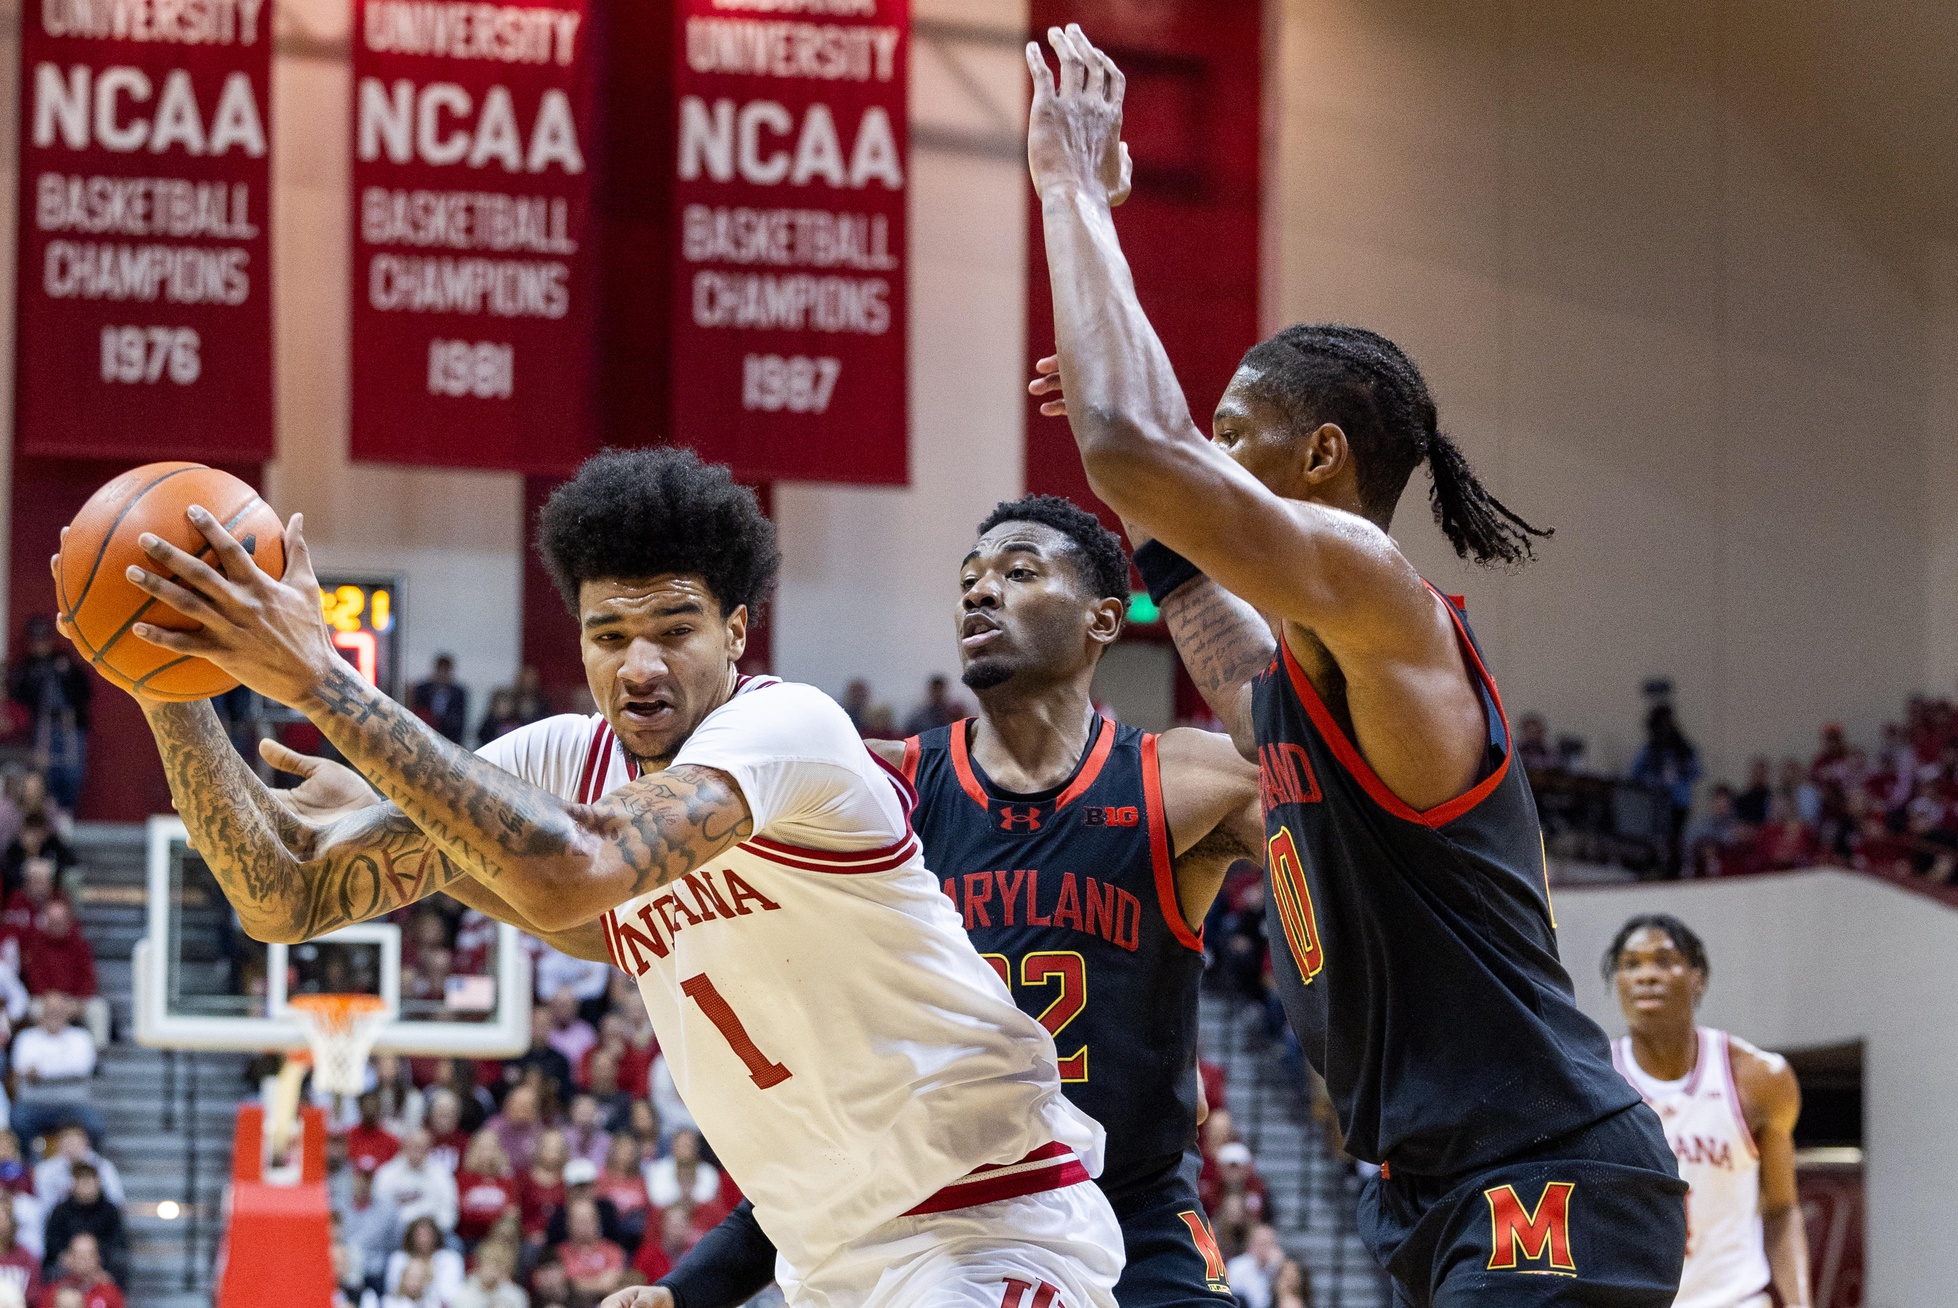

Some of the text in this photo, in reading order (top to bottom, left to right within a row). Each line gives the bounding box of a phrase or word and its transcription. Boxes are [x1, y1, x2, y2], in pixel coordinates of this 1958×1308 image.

[41, 0, 264, 46] UNIVERSITY
[364, 0, 580, 67] UNIVERSITY
[685, 14, 899, 82] UNIVERSITY
[33, 62, 267, 157] NCAA
[358, 76, 586, 174] NCAA
[677, 95, 904, 190] NCAA
[36, 171, 259, 240] BASKETBALL
[361, 186, 578, 255] BASKETBALL
[682, 203, 898, 271] BASKETBALL
[44, 239, 251, 306] CHAMPIONS
[369, 253, 571, 319] CHAMPIONS
[692, 269, 891, 335] CHAMPIONS
[101, 324, 201, 385] 1976
[427, 338, 514, 399] 1981
[741, 352, 842, 414] 1987
[943, 869, 1141, 952] ARYLAND
[680, 972, 793, 1090] 1
[979, 951, 1088, 1083] 2
[1484, 1181, 1576, 1270] M
